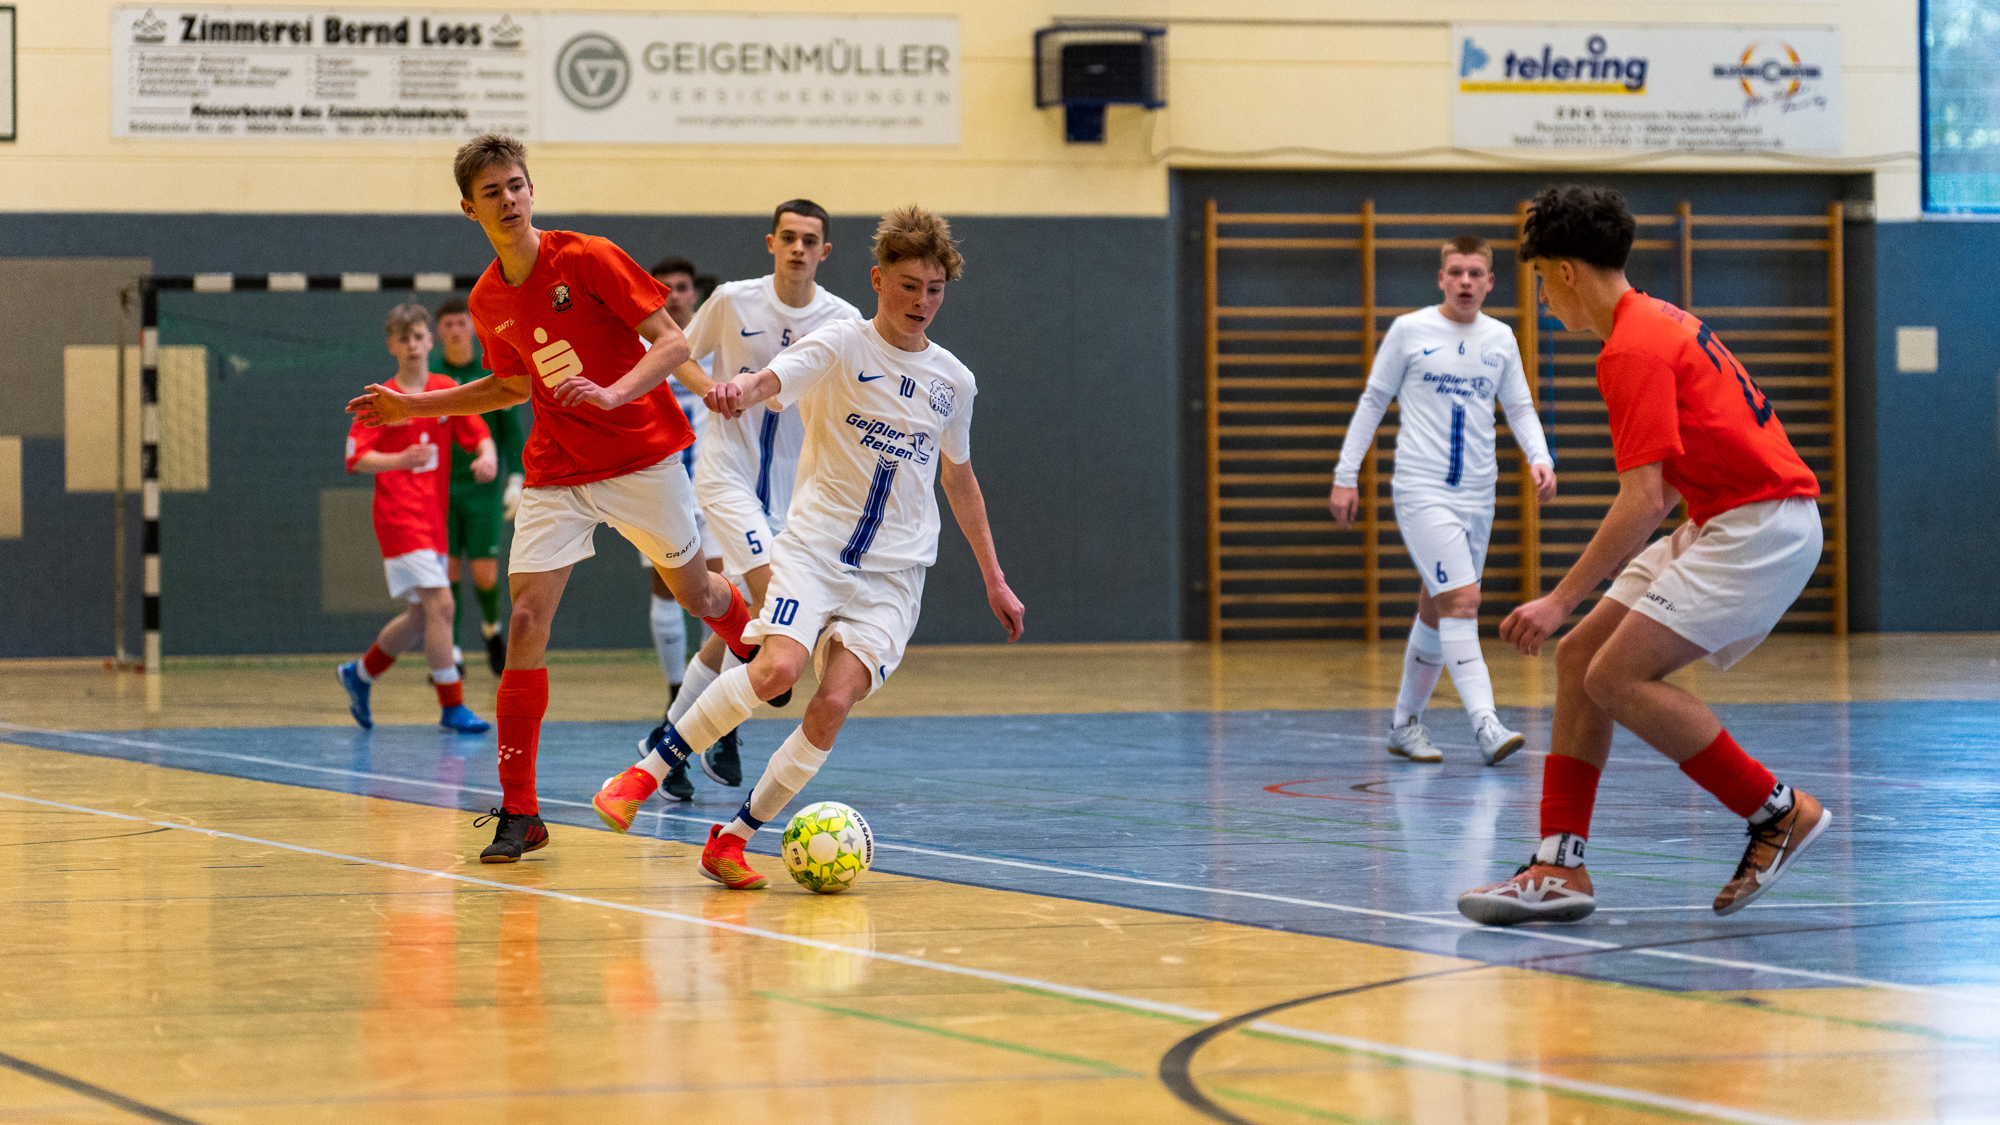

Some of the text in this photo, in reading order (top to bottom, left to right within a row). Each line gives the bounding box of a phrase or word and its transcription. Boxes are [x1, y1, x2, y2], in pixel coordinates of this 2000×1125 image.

[180, 15, 482, 45] Zimmerei Bernd Loos
[642, 37, 951, 76] GEIGENMÜLLER
[1503, 34, 1649, 91] telering
[781, 328, 792, 347] 5
[1458, 340, 1466, 355] 6
[899, 374, 917, 399] 10
[845, 413, 906, 441] Geißler
[860, 434, 913, 460] Reisen
[666, 540, 693, 559] CRAFT
[745, 530, 764, 555] 5
[1436, 561, 1449, 584] 6
[770, 597, 800, 626] 10
